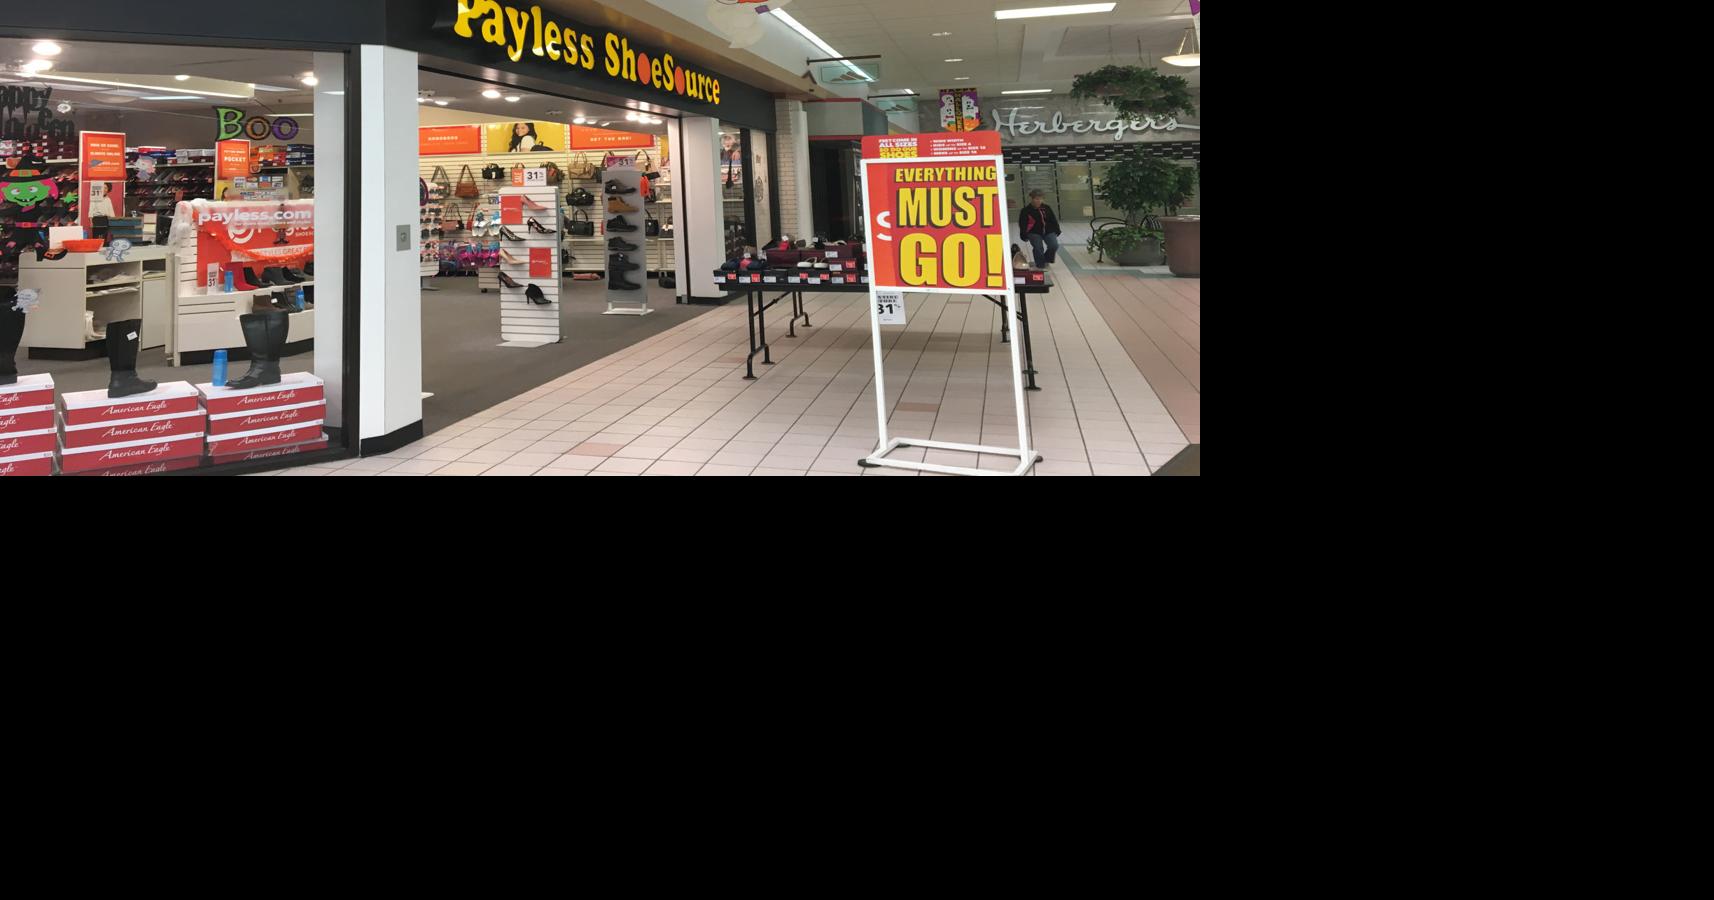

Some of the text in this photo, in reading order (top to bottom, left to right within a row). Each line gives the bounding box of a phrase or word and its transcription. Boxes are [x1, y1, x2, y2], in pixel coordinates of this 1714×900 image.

[454, 0, 721, 105] Payless ShoeSource
[0, 85, 52, 120] appy
[895, 165, 996, 182] EVERYTHING
[198, 204, 312, 226] payless.com
[897, 186, 999, 228] MUST
[900, 232, 1004, 288] GO!
[237, 390, 296, 405] American Eagle
[102, 400, 167, 416] American Eagle
[240, 410, 298, 426] American Eagle
[102, 421, 173, 437] American Eagle
[237, 430, 296, 446] American Eagle
[99, 443, 171, 461] American Eagle
